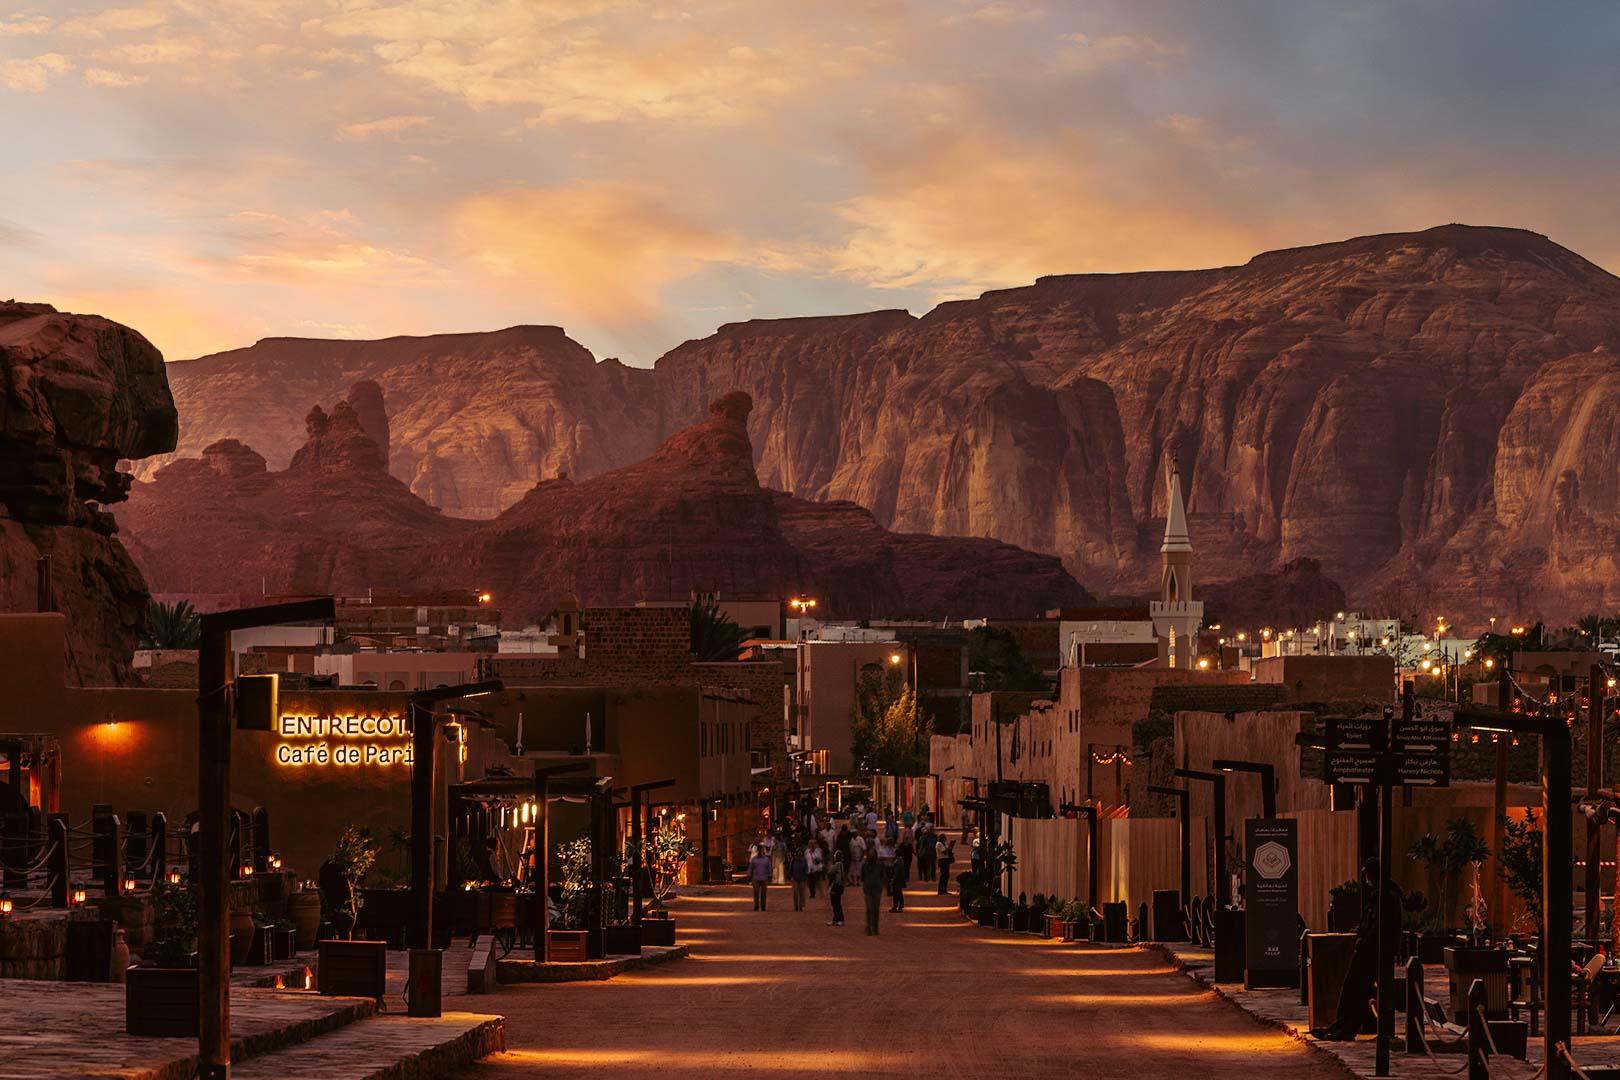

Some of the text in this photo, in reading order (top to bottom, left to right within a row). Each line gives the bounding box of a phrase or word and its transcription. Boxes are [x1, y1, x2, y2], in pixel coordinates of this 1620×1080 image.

[282, 716, 409, 734] ENTRECOT
[278, 742, 414, 764] Café de Pari
